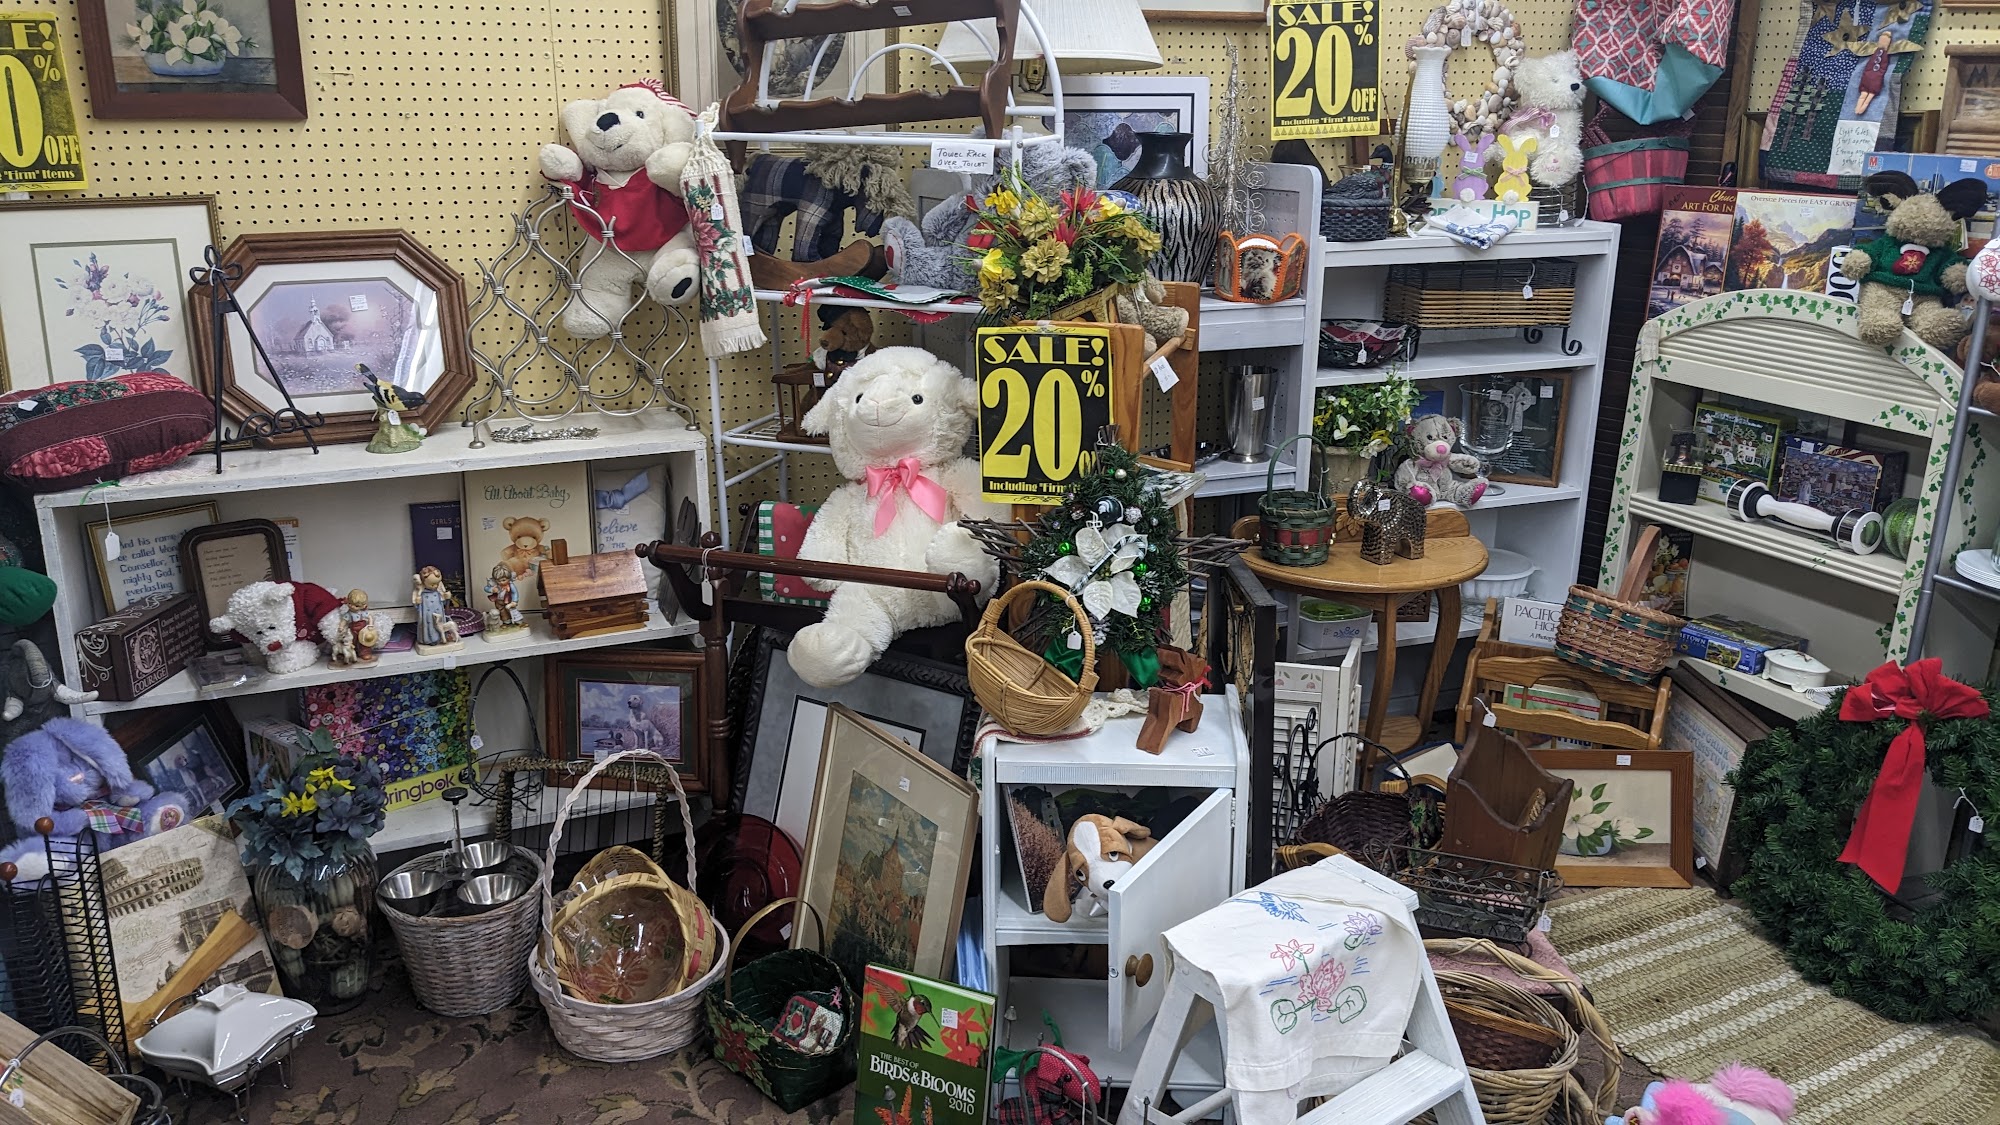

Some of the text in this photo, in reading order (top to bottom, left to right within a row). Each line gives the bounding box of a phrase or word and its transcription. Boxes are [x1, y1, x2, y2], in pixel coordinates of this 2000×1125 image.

[1278, 1, 1374, 27] SALE!
[0, 22, 55, 50] E!
[1276, 25, 1353, 117] 20
[1351, 88, 1377, 113] OFF
[1281, 117, 1319, 126] Including
[44, 135, 80, 165] OFF
[42, 169, 75, 180] Items
[1681, 201, 1700, 211] ART
[1701, 202, 1719, 212] FOR
[1810, 198, 1828, 206] EASY
[983, 335, 1104, 366] SALE!
[982, 368, 1082, 481] 20
[502, 484, 535, 500] About
[990, 481, 1038, 493] Including
[431, 517, 452, 525] GIRLS
[132, 547, 155, 559] called
[120, 559, 167, 573] Counsellor,
[123, 573, 152, 586] mighty
[126, 582, 174, 597] everlasting
[1514, 605, 1562, 622] PACIFIC
[134, 666, 166, 693] COURAGE
[880, 1052, 893, 1060] THE
[894, 1056, 908, 1066] BEST
[870, 1054, 911, 1082] BIRDS
[920, 1070, 976, 1104] BLOOMS
[949, 1097, 974, 1115] 2010
